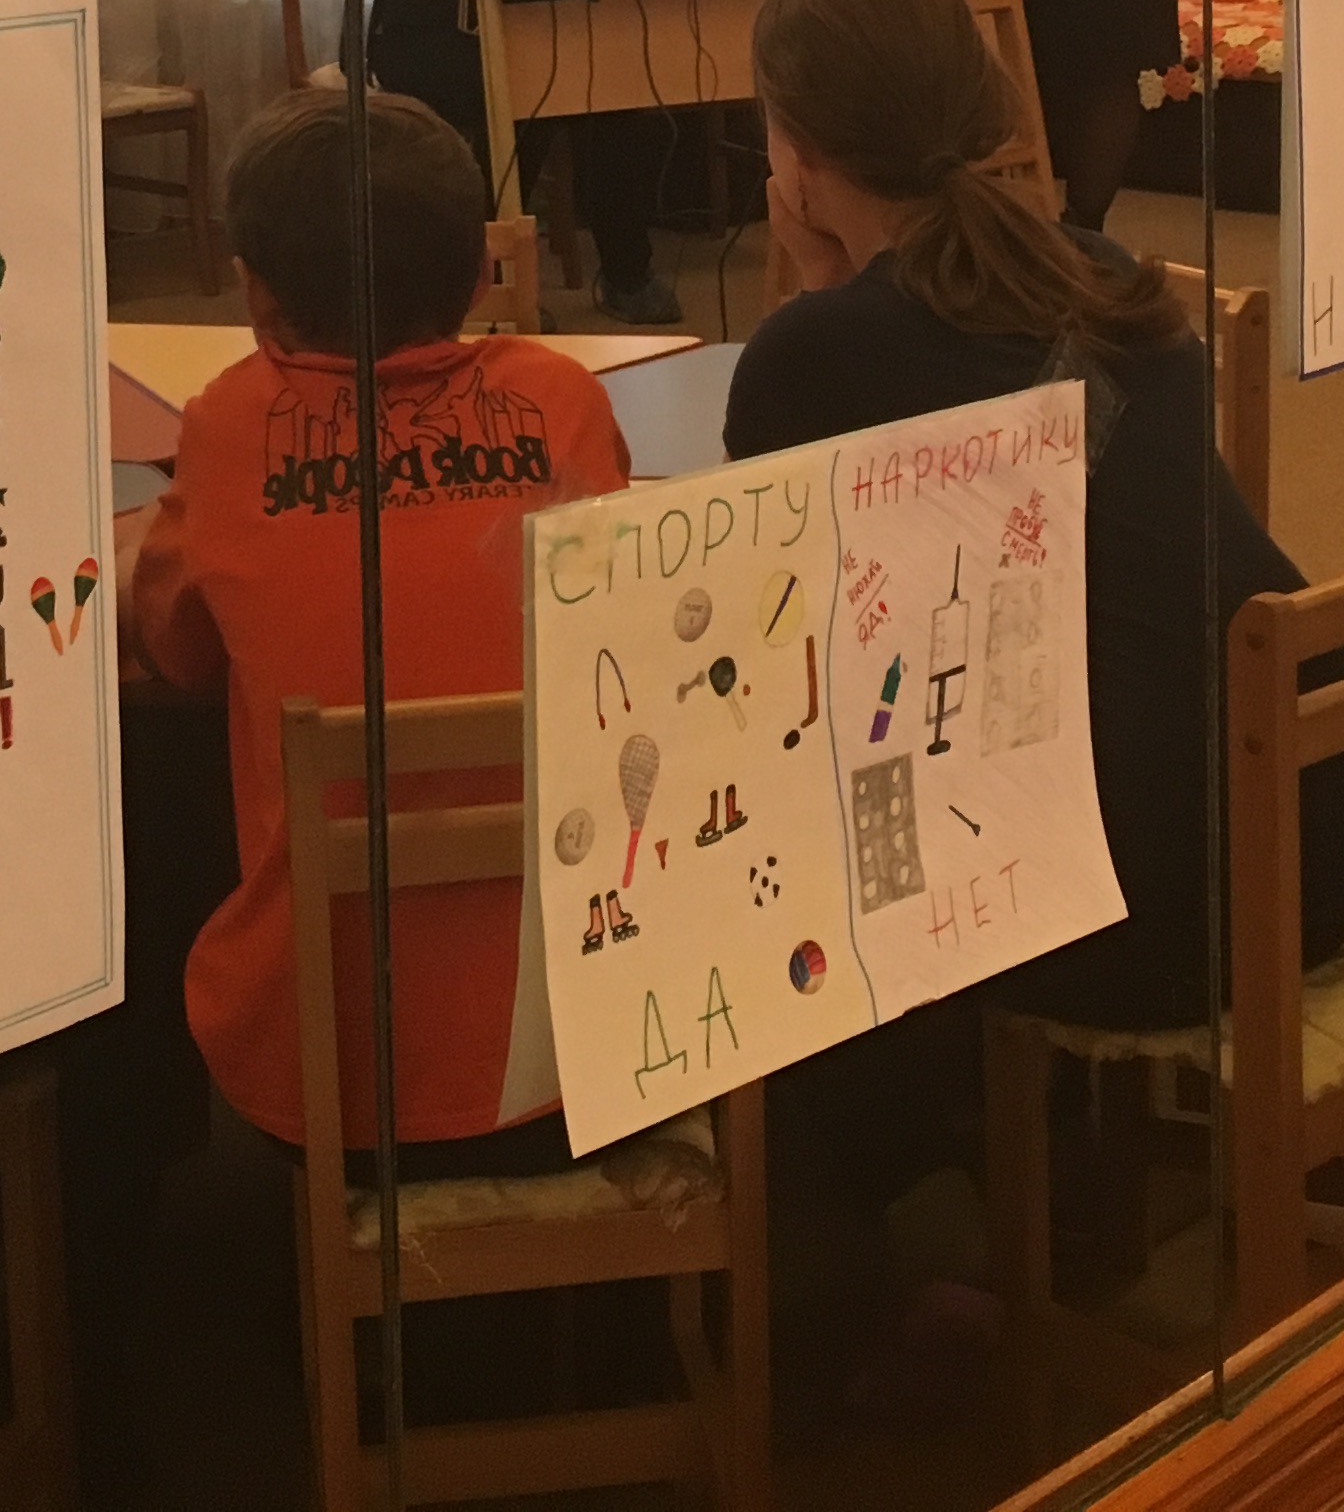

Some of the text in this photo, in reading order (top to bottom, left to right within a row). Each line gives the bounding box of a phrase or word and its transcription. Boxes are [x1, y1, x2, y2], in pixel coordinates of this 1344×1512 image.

[851, 417, 1081, 513] НАРКОТИКУ
[545, 478, 811, 606] СПОРТУ
[926, 859, 1025, 950] НЕТ
[634, 965, 740, 1100] ДА
